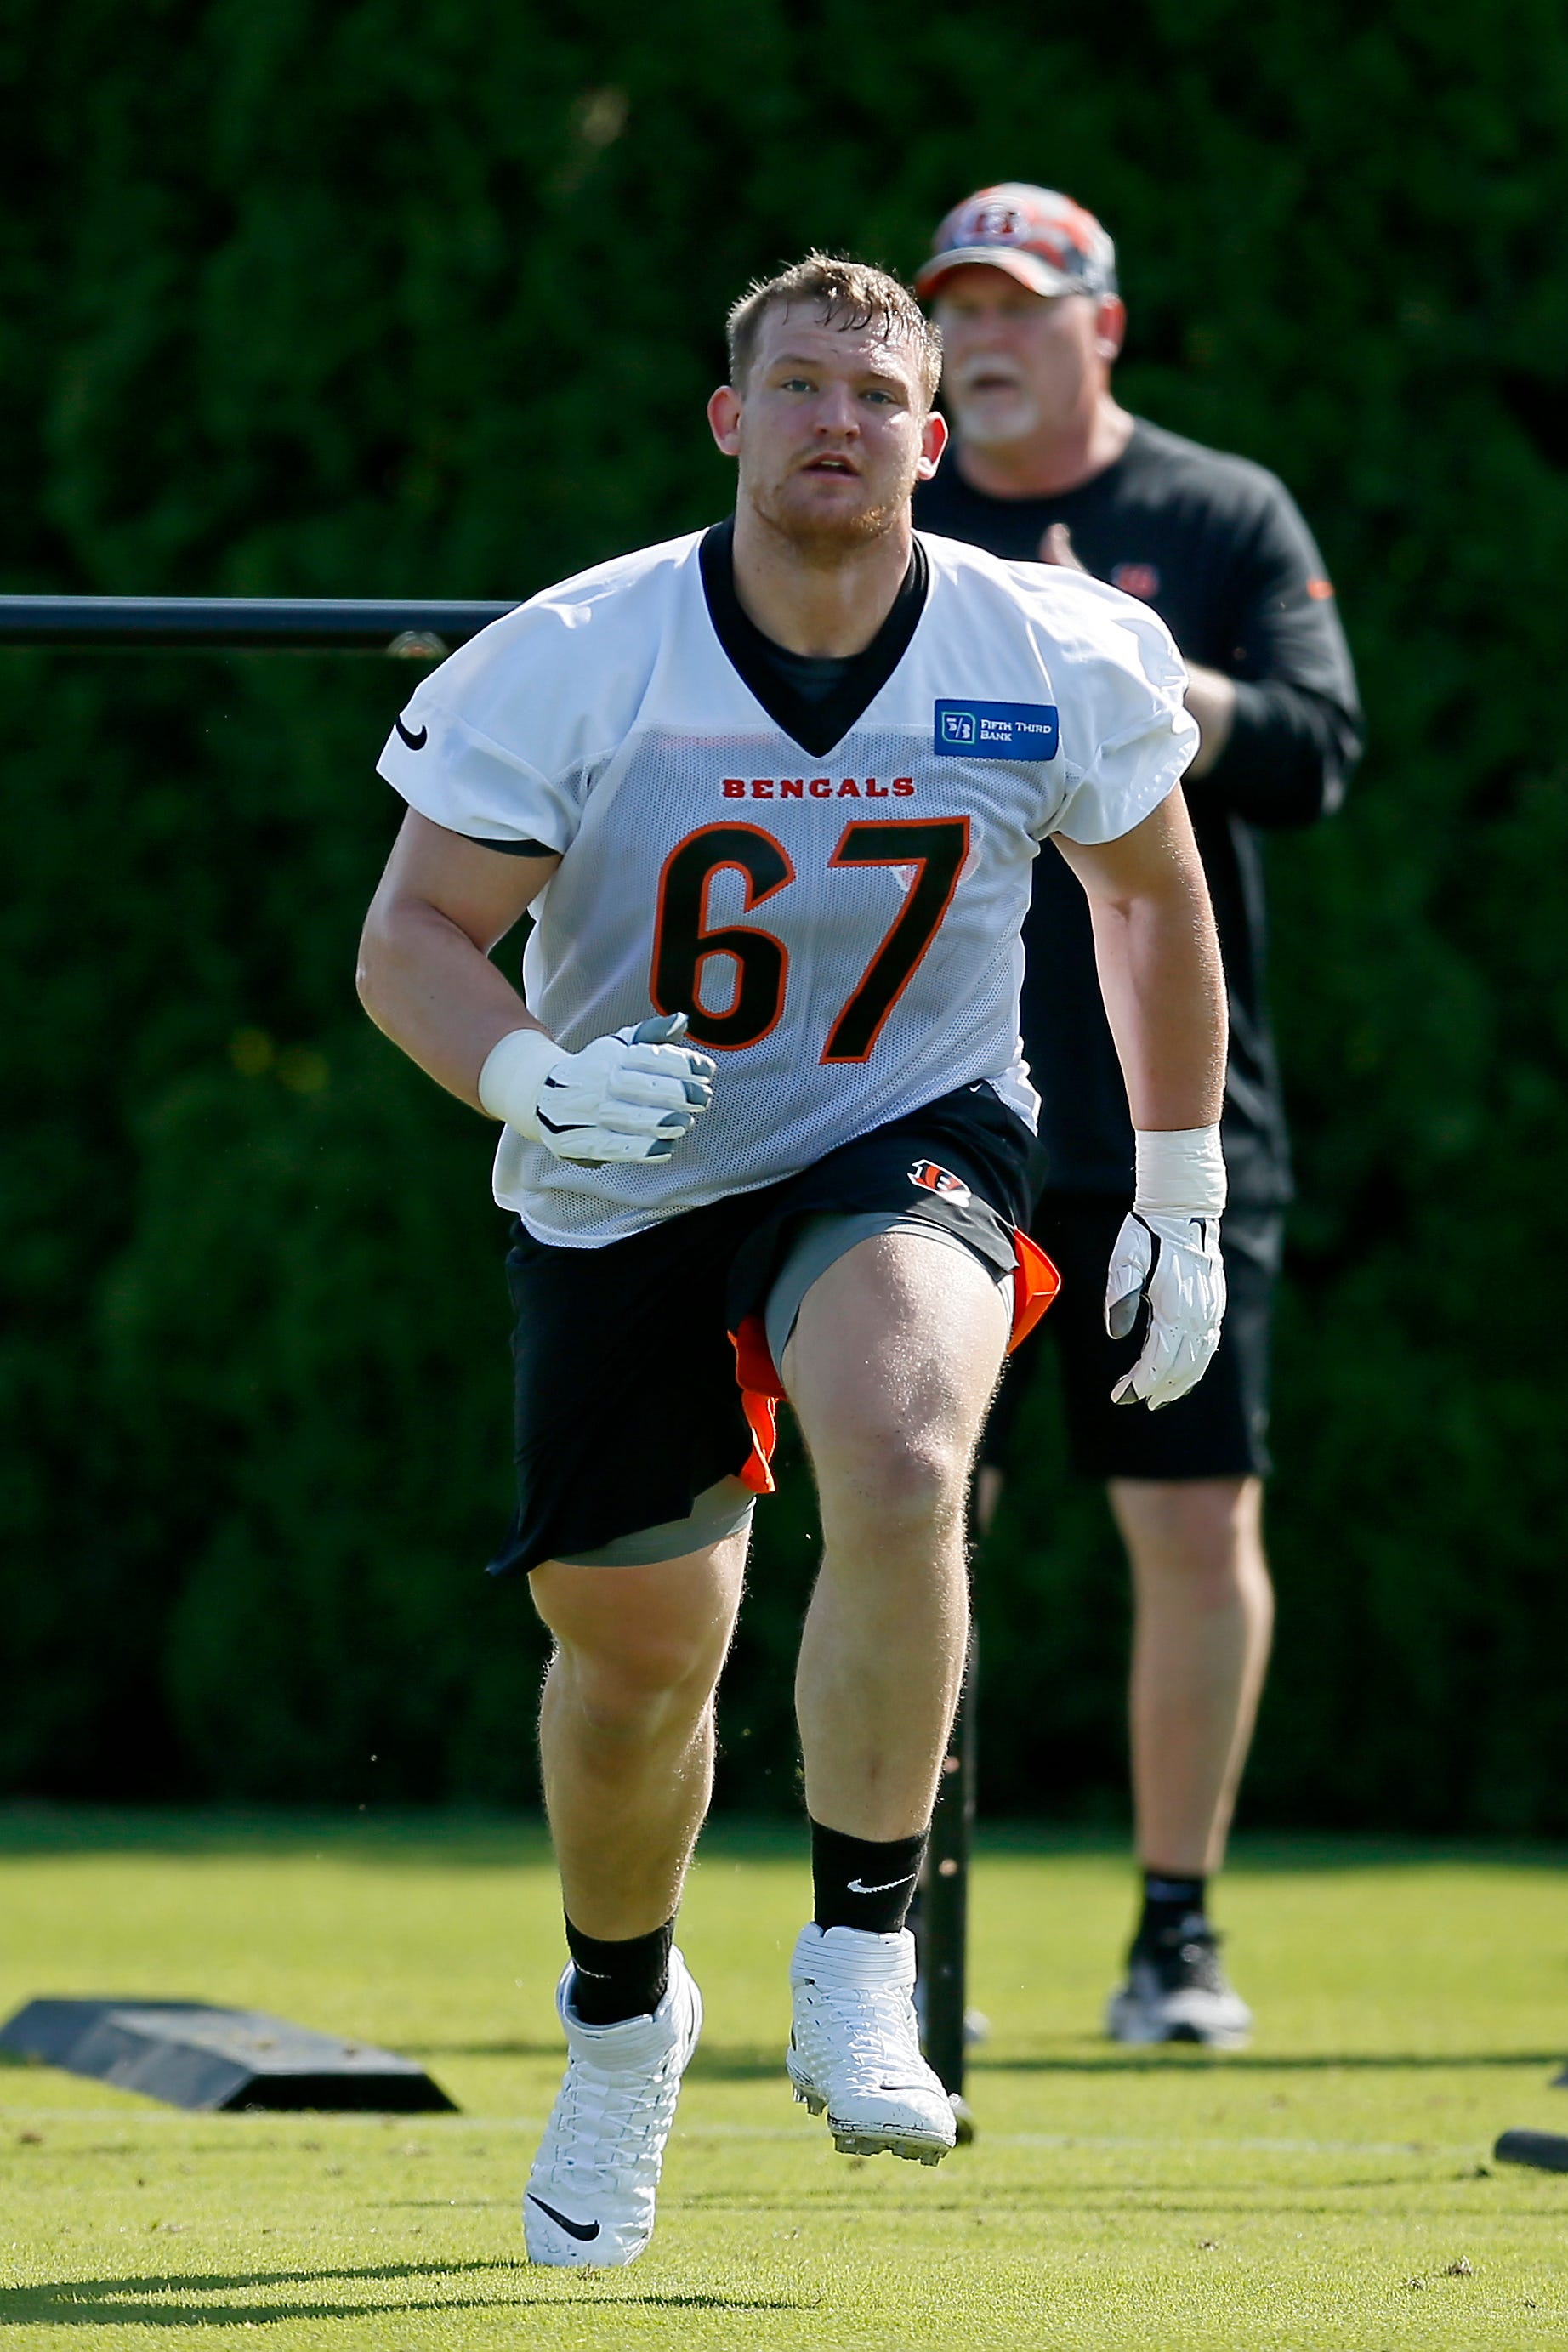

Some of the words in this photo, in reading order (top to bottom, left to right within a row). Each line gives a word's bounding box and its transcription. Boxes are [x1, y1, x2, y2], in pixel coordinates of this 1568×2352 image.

[980, 719, 1012, 731] FIFTH
[1015, 722, 1052, 734] THIRD
[980, 730, 1012, 741] BANK
[722, 777, 915, 799] BENGALS
[649, 815, 970, 1065] 67
